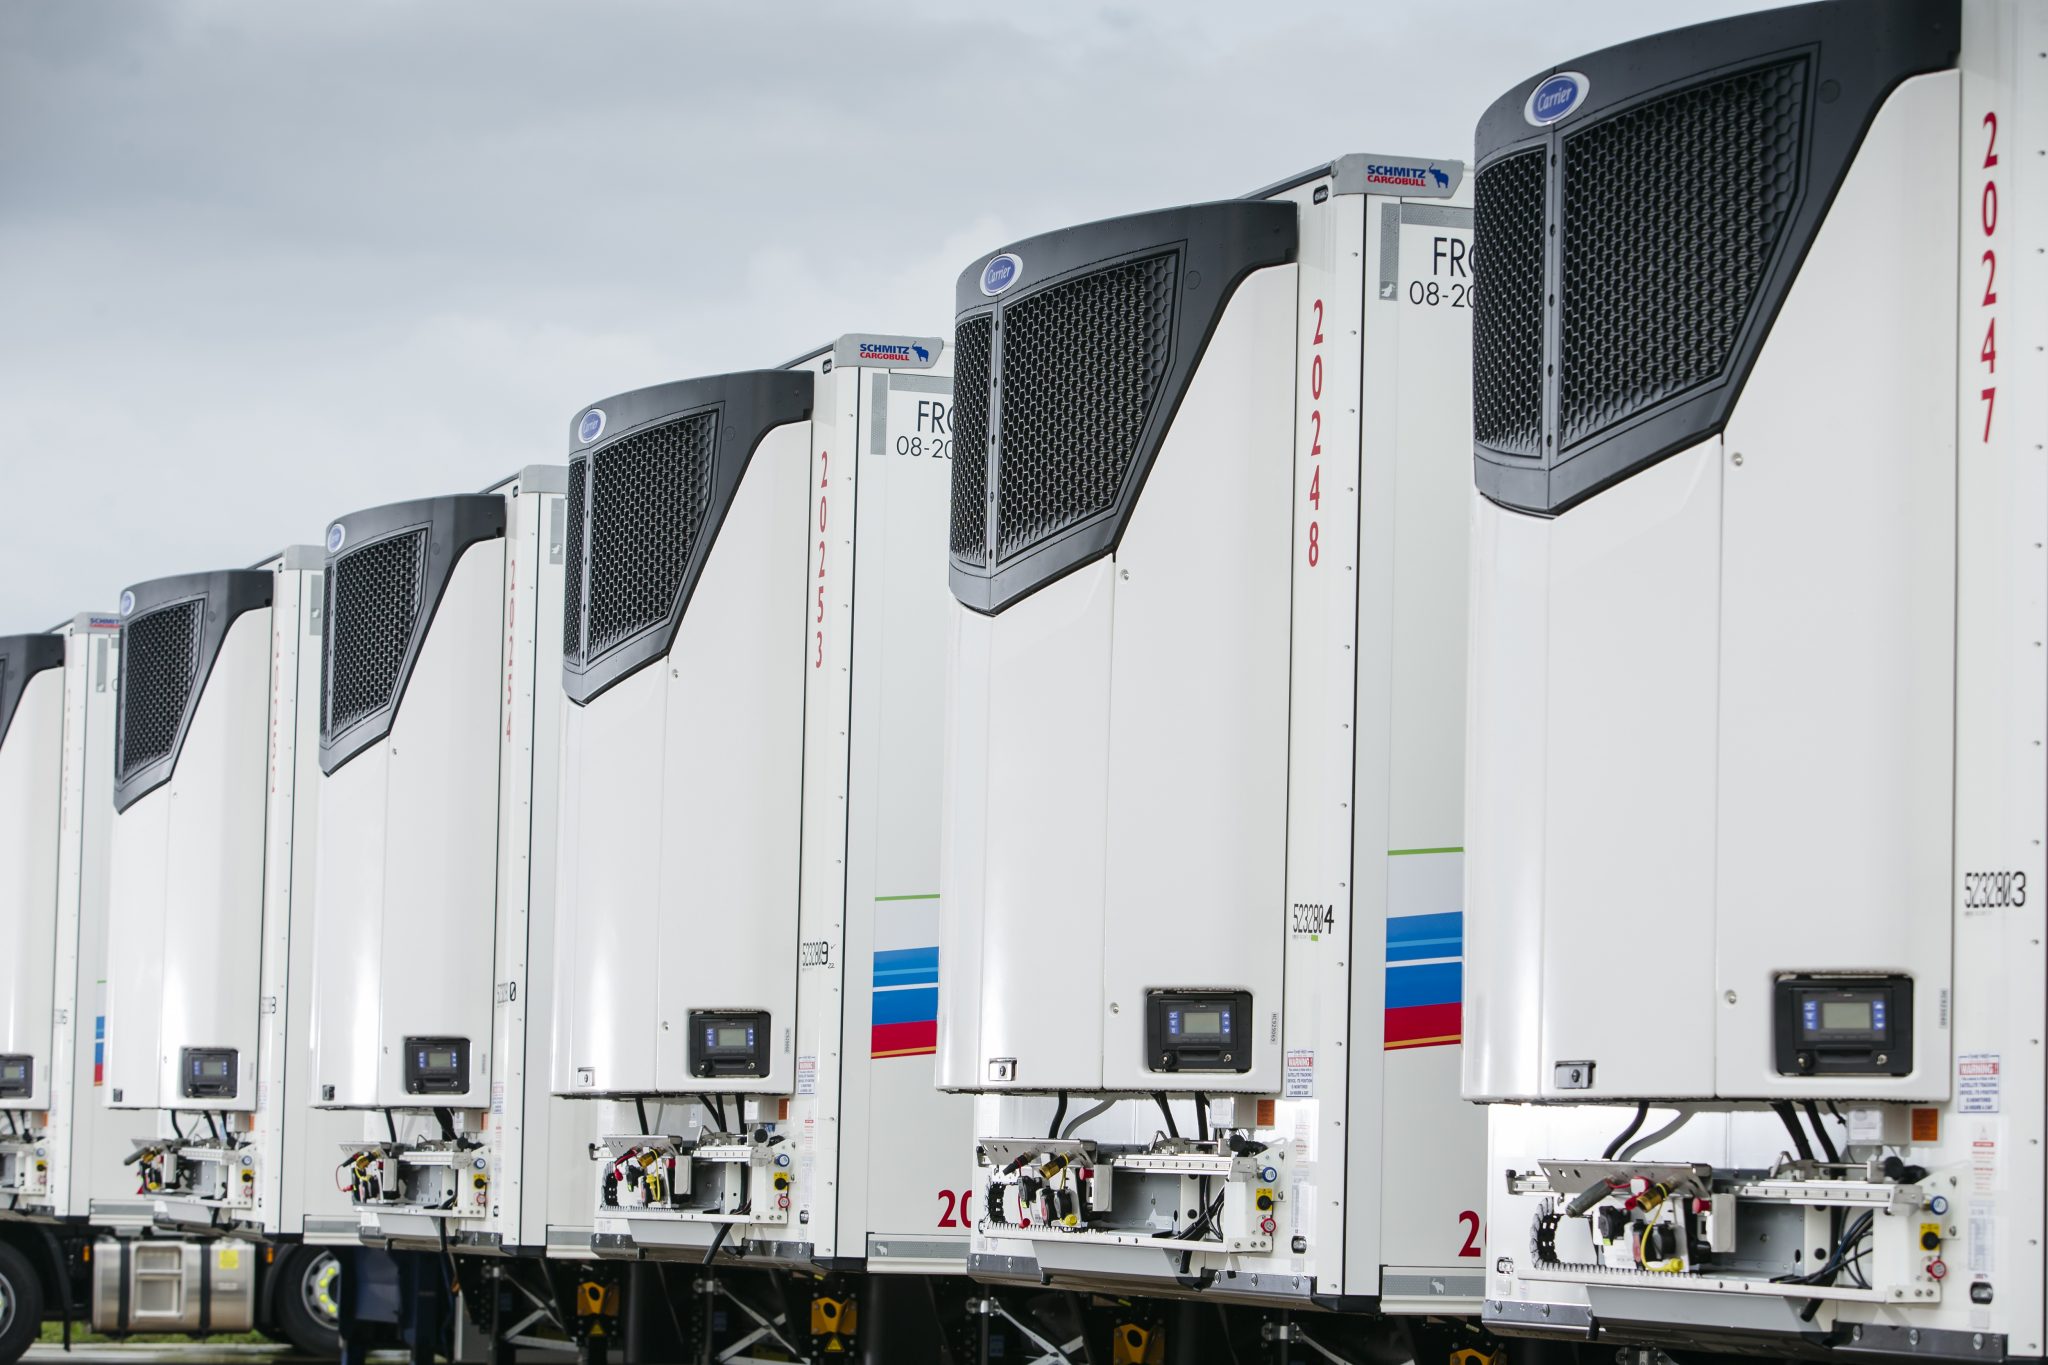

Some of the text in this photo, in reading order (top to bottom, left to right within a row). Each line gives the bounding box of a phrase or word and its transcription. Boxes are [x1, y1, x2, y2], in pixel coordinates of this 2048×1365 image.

[1537, 86, 1573, 112] Carrier
[1367, 164, 1427, 179] SCHMITZ
[1367, 174, 1427, 187] CARGOBULL
[1981, 111, 1998, 444] 20247
[860, 343, 910, 355] SCHMITZ
[860, 351, 910, 362] CARGOBULL
[1308, 298, 1324, 567] 20248
[815, 450, 828, 669] 20253
[1964, 870, 2026, 908] 5232803
[1292, 903, 1335, 935] 5232804
[1458, 1210, 1487, 1257] 2
